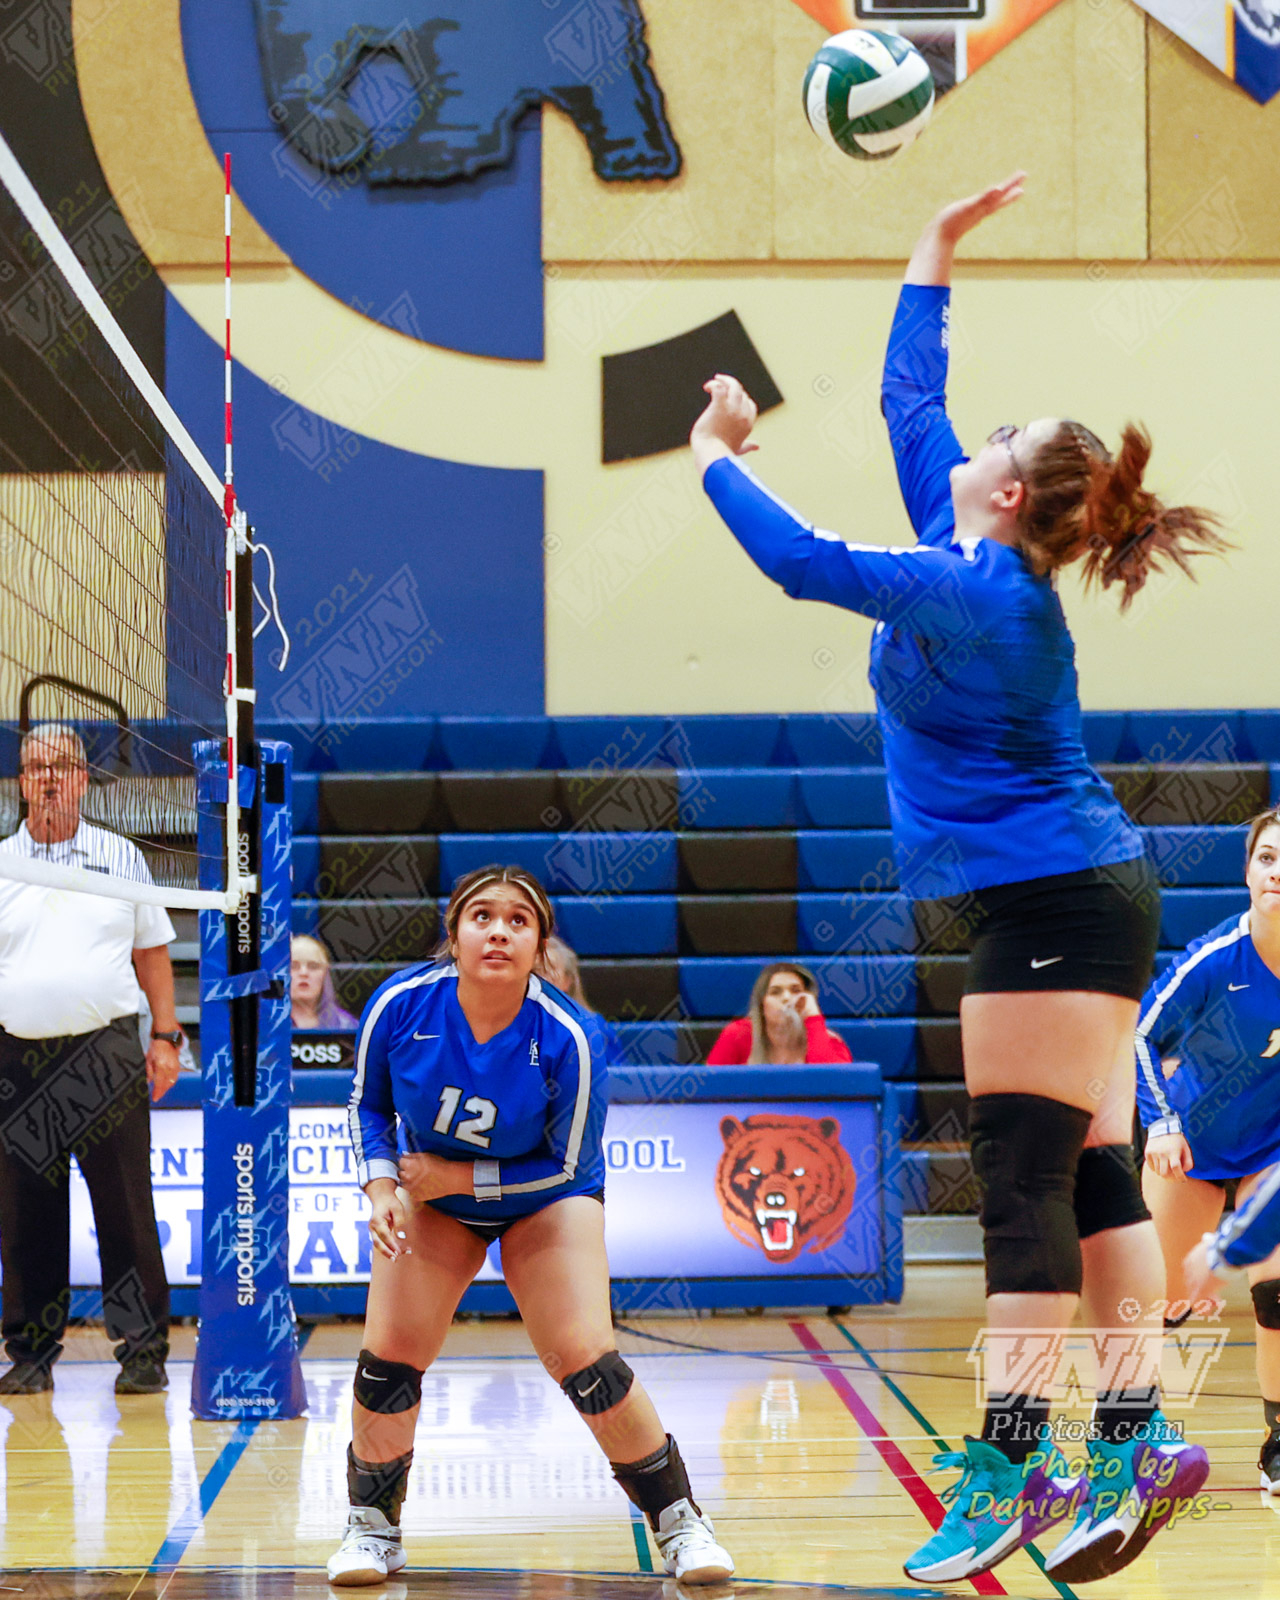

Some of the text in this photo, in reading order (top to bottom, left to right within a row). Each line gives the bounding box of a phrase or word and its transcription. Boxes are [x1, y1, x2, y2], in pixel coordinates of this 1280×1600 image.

[237, 893, 252, 953] mports
[432, 1085, 498, 1149] 12
[232, 1143, 257, 1307] sports imports
